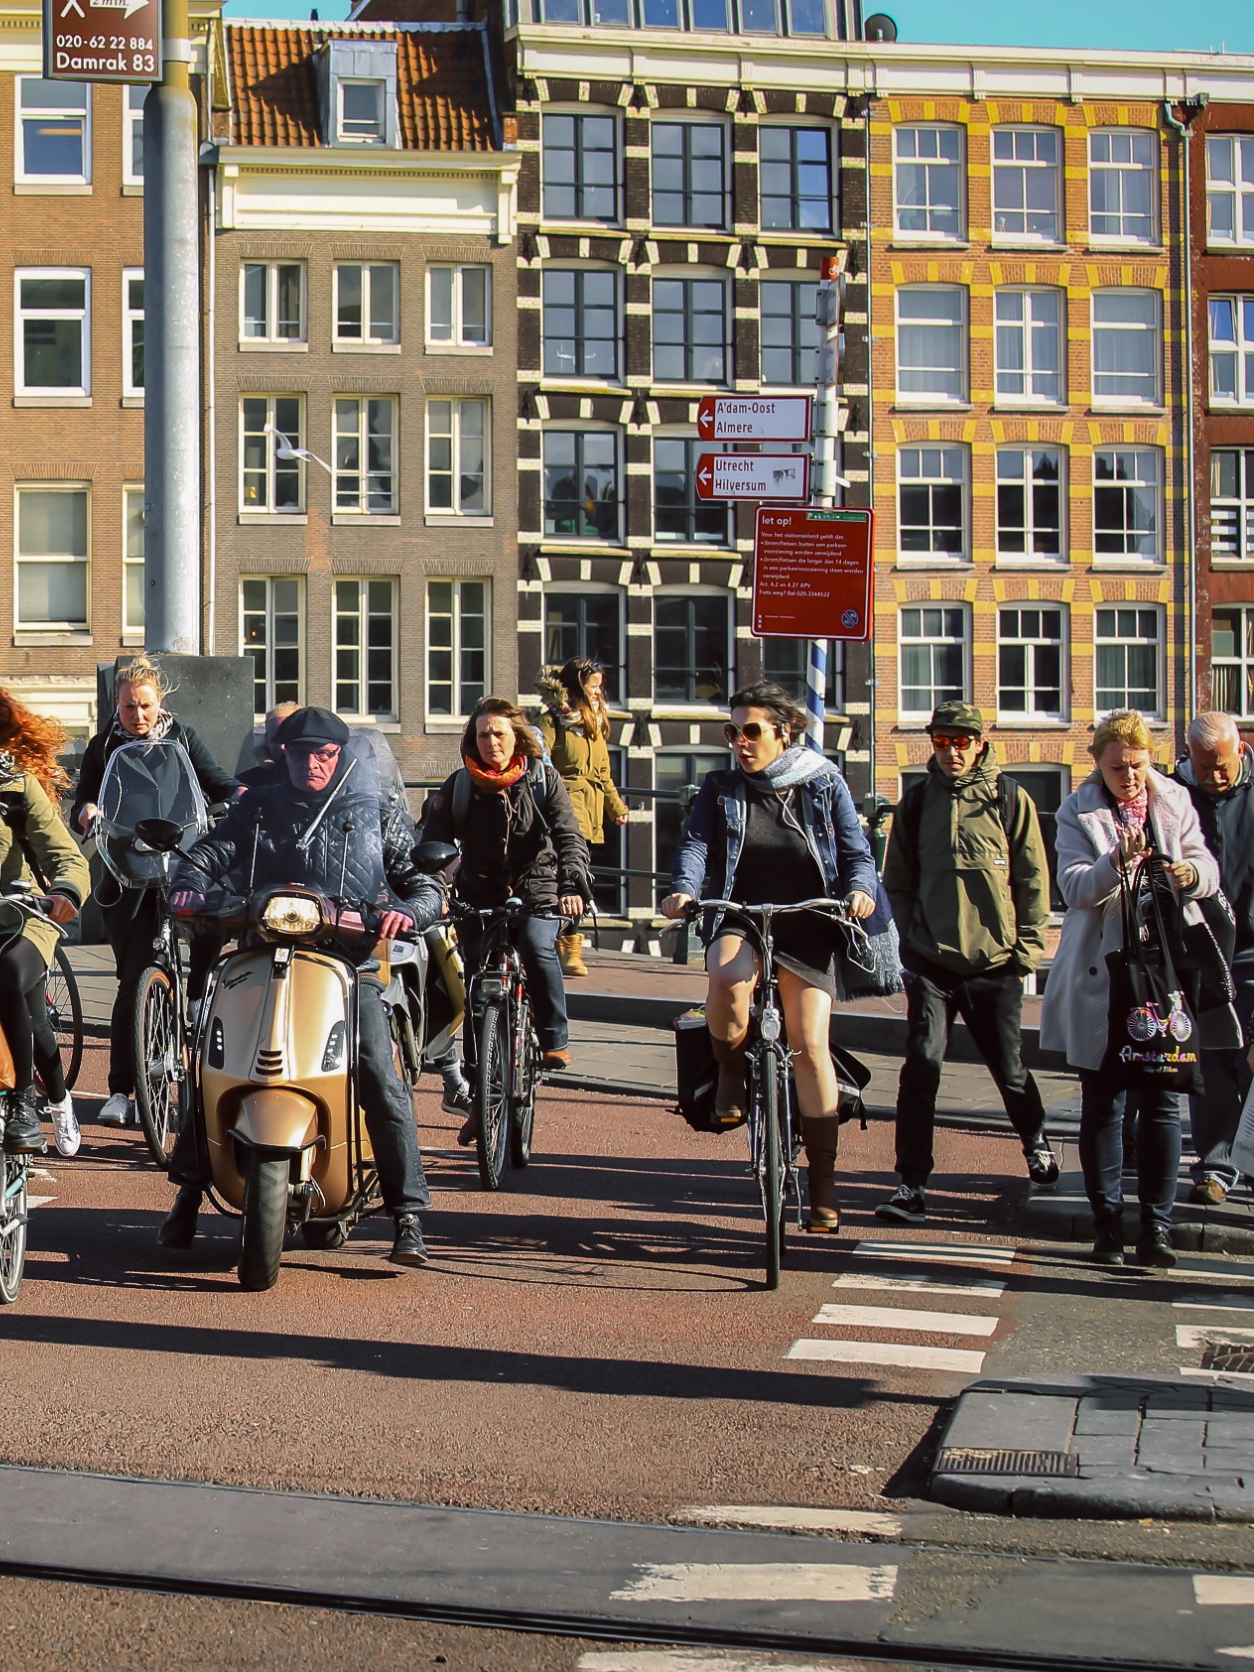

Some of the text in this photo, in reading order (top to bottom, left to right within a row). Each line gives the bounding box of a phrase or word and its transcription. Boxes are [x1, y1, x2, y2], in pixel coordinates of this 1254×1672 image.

[56, 34, 154, 51] 020-62 22 884
[56, 52, 155, 72] Damrak 83
[717, 402, 776, 414] A'dam-Oost
[716, 421, 753, 433] Almere
[715, 459, 754, 472] Utrecht
[715, 479, 767, 492] Hilversum
[777, 516, 792, 527] op!
[1119, 1045, 1197, 1063] Amsterdam
